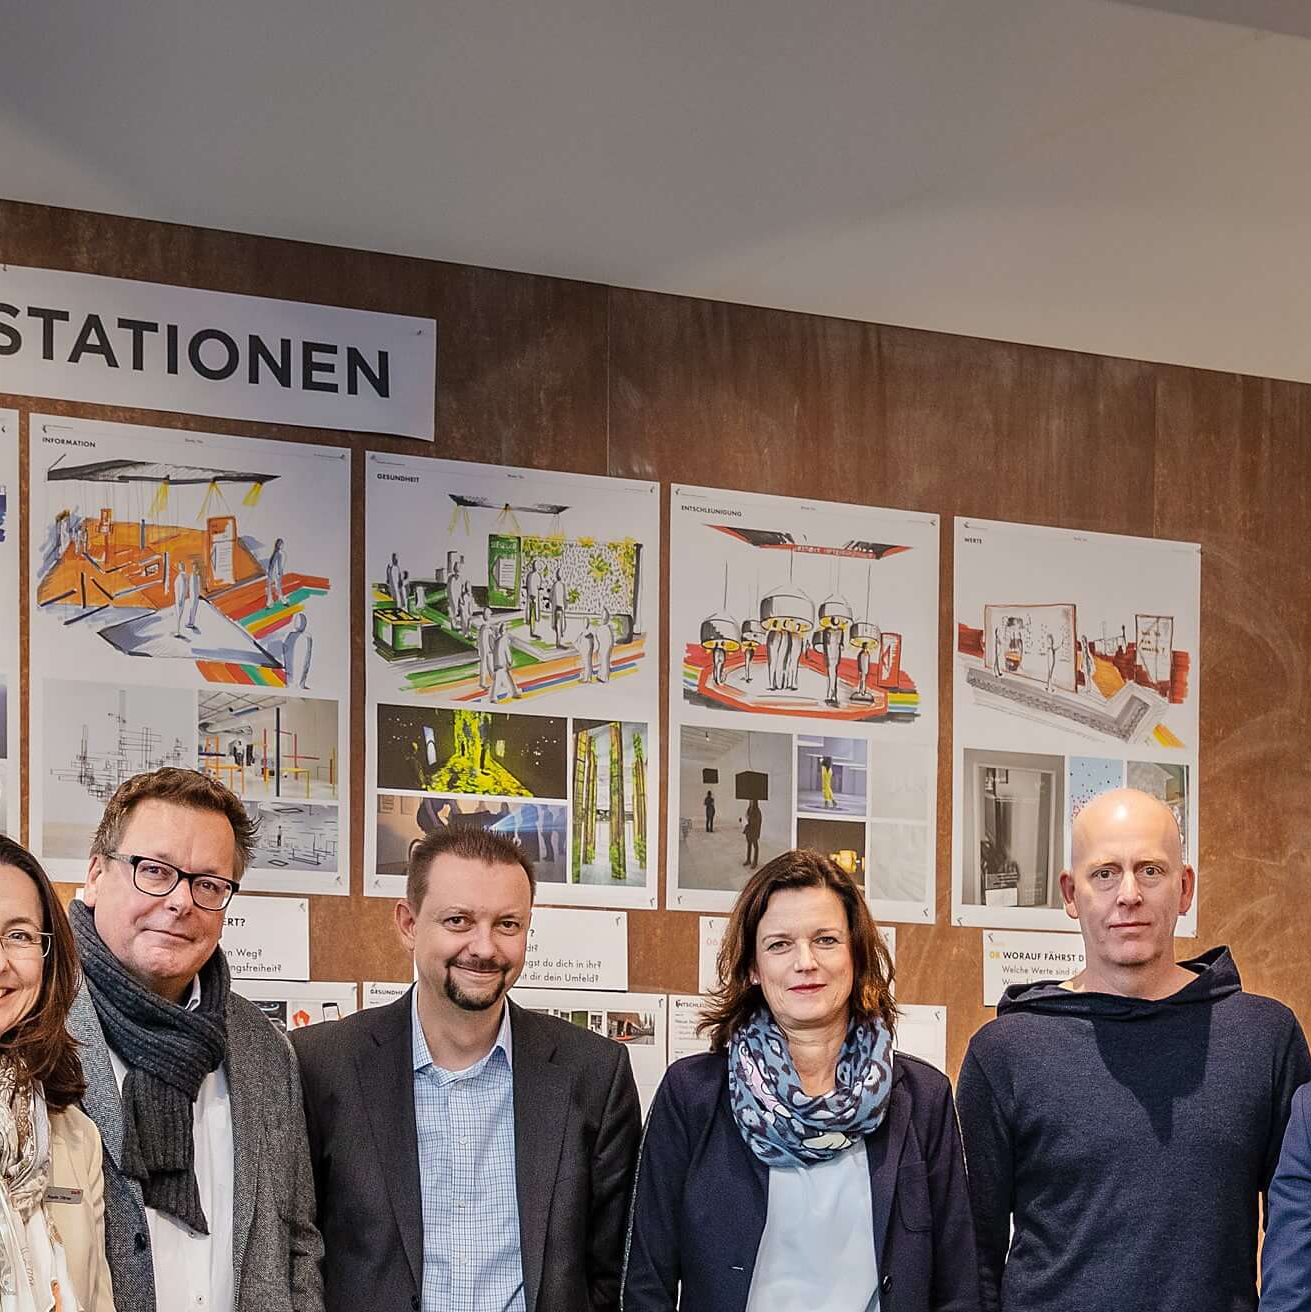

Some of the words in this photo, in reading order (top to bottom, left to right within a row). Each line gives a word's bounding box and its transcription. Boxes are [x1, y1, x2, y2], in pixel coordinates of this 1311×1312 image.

[42, 436, 96, 449] INFORMATION
[376, 473, 420, 484] GESUNDHEIT
[681, 504, 742, 518] ENTSCHLEUNIGUNG
[964, 536, 983, 545] WERTE
[236, 948, 263, 960] Weg?
[1002, 952, 1041, 962] WORAUF
[1044, 950, 1076, 962] FÄHRST
[230, 962, 282, 974] ngsfreiheit?
[543, 958, 554, 968] du
[556, 958, 574, 969] dich
[576, 959, 584, 969] in
[586, 960, 602, 970] ihr?
[1001, 965, 1028, 975] Welche
[1032, 966, 1053, 975] Werte
[1056, 967, 1070, 976] sind
[530, 972, 541, 981] dir
[544, 972, 562, 982] dein
[565, 974, 599, 983] Umfeld?
